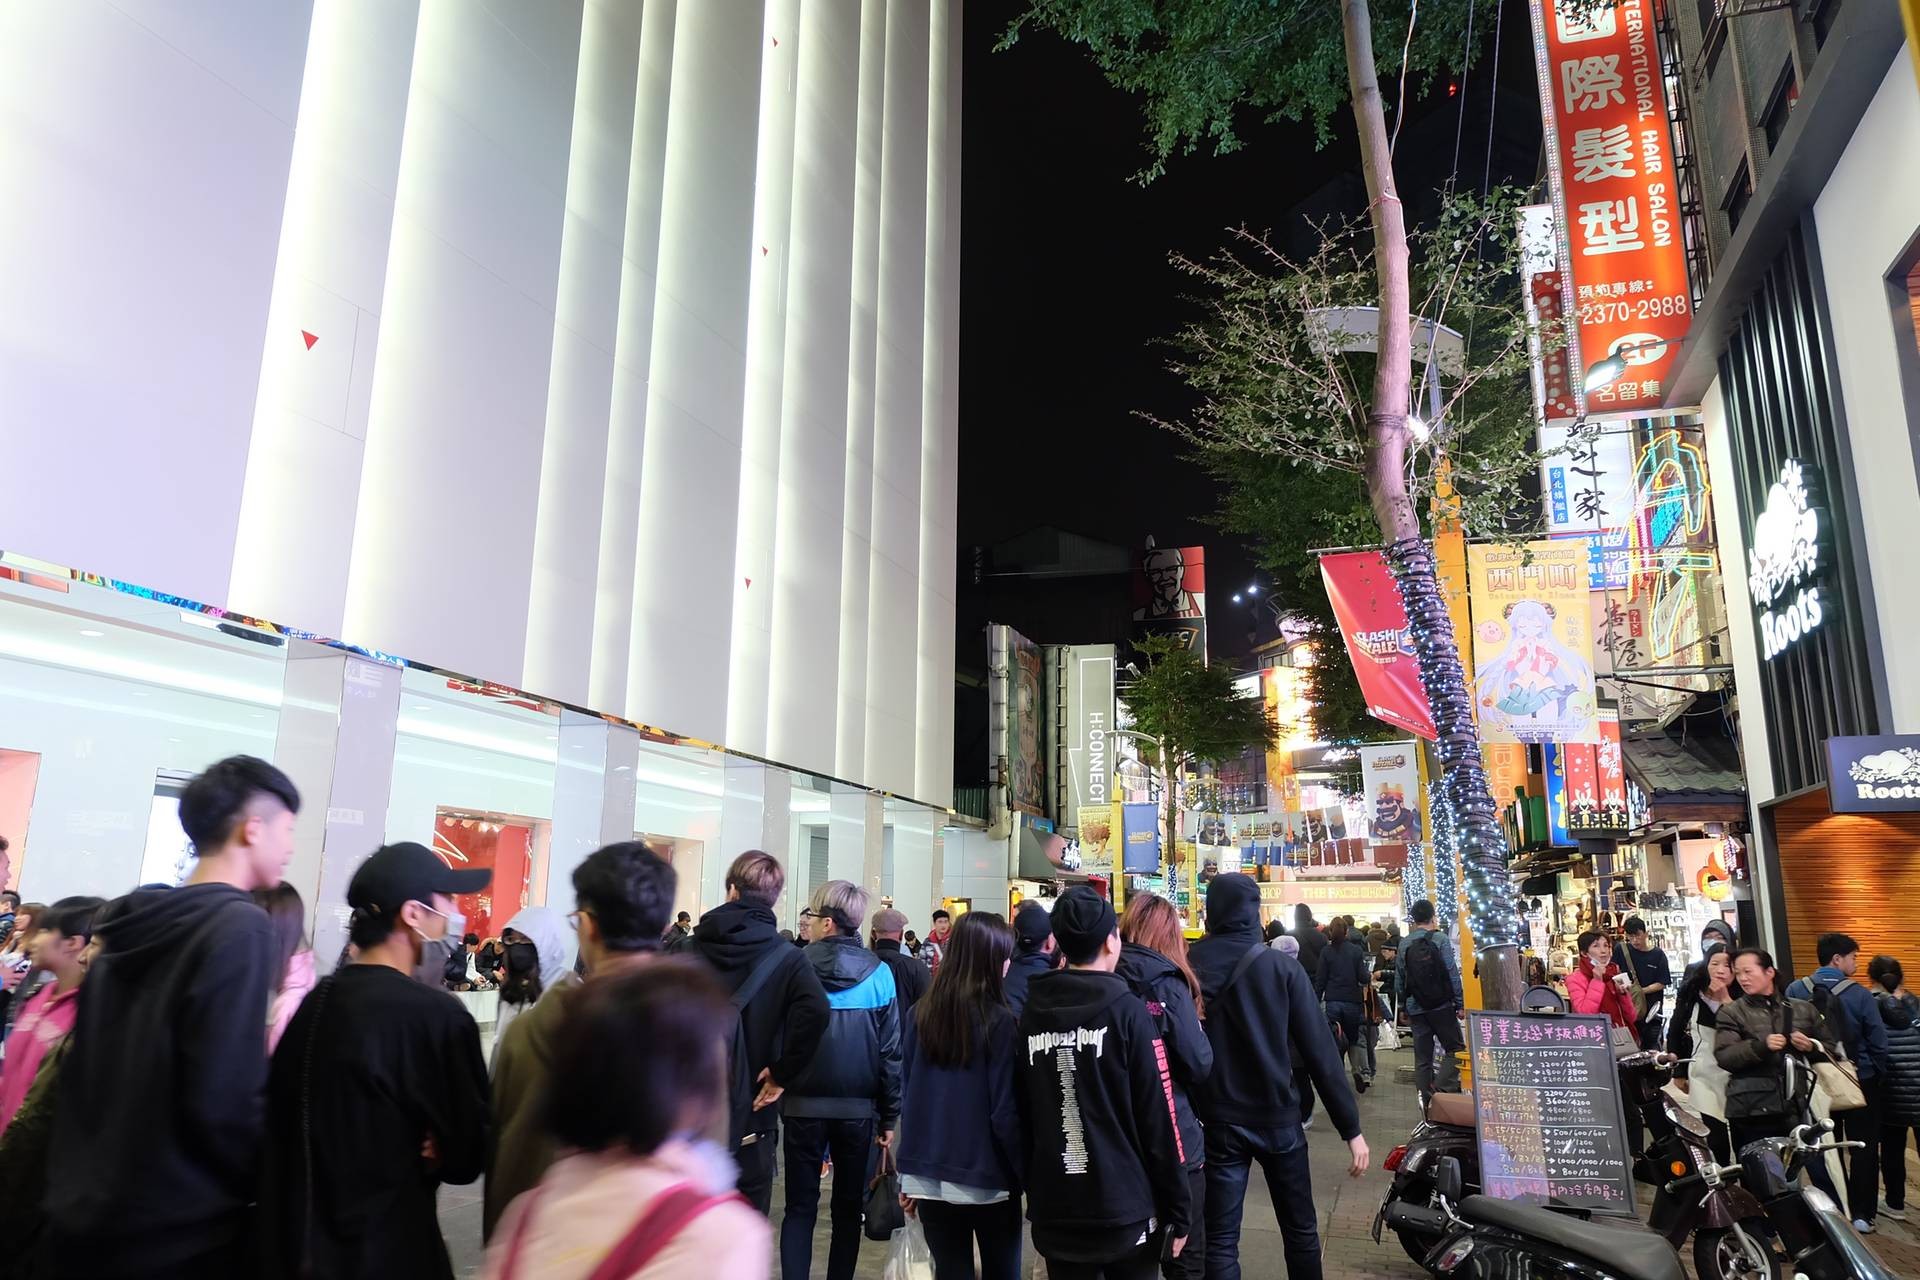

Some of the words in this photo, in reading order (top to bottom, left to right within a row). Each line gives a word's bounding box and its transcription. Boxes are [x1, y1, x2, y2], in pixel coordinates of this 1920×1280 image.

[1641, 130, 1663, 175] HAIR
[1647, 183, 1672, 247] SALON
[1582, 295, 1687, 325] 2370-2988
[1596, 380, 1661, 403] 名留集
[1552, 468, 1567, 522] 台北旗艦店
[1487, 564, 1577, 592] 西門町
[1760, 587, 1822, 661] Roots
[1090, 712, 1105, 804] H:CONNECT
[1539, 1050, 1583, 1058] 1500/1500
[1540, 1060, 1586, 1068] 2200/2800
[1545, 1097, 1591, 1106] 3600/4200
[1562, 1168, 1600, 1177] 800/800
